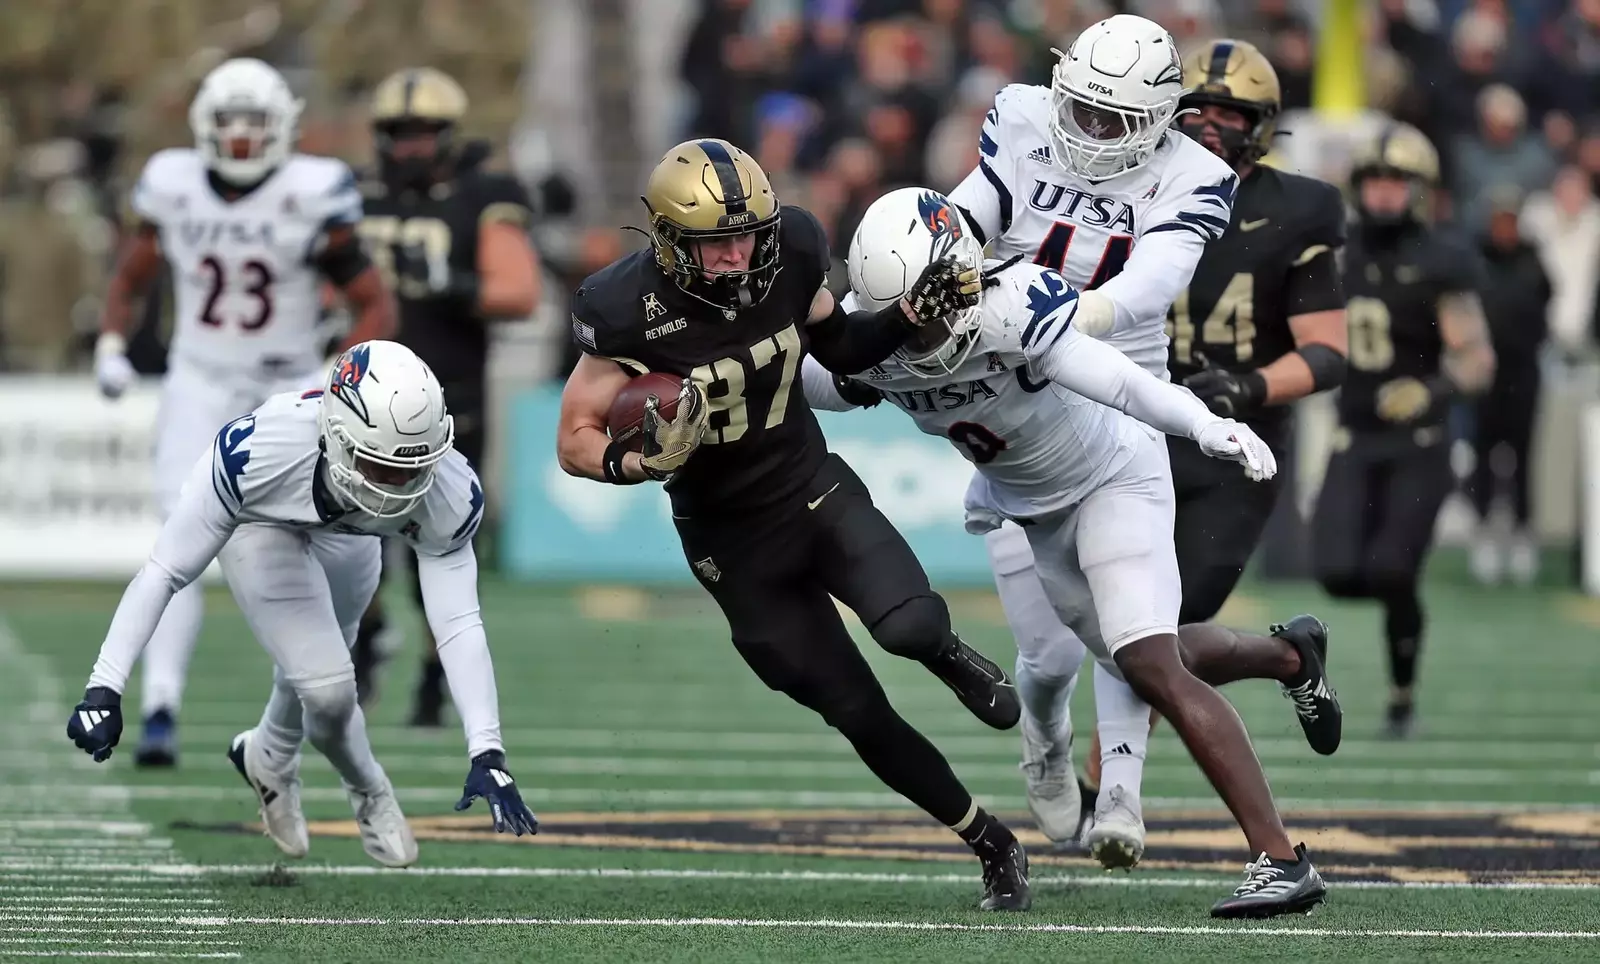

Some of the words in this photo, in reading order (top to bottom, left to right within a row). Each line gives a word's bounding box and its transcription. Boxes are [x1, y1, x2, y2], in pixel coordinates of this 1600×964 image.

[1087, 81, 1113, 97] UTSA
[1027, 152, 1053, 165] adidas
[1029, 179, 1135, 234] UTSA
[728, 213, 749, 226] ARMY
[196, 254, 275, 332] 23
[645, 316, 688, 341] REYNOLDS
[689, 322, 802, 445] 87
[869, 373, 893, 381] adidas
[882, 378, 999, 413] UTSA
[399, 446, 426, 455] UTSA
